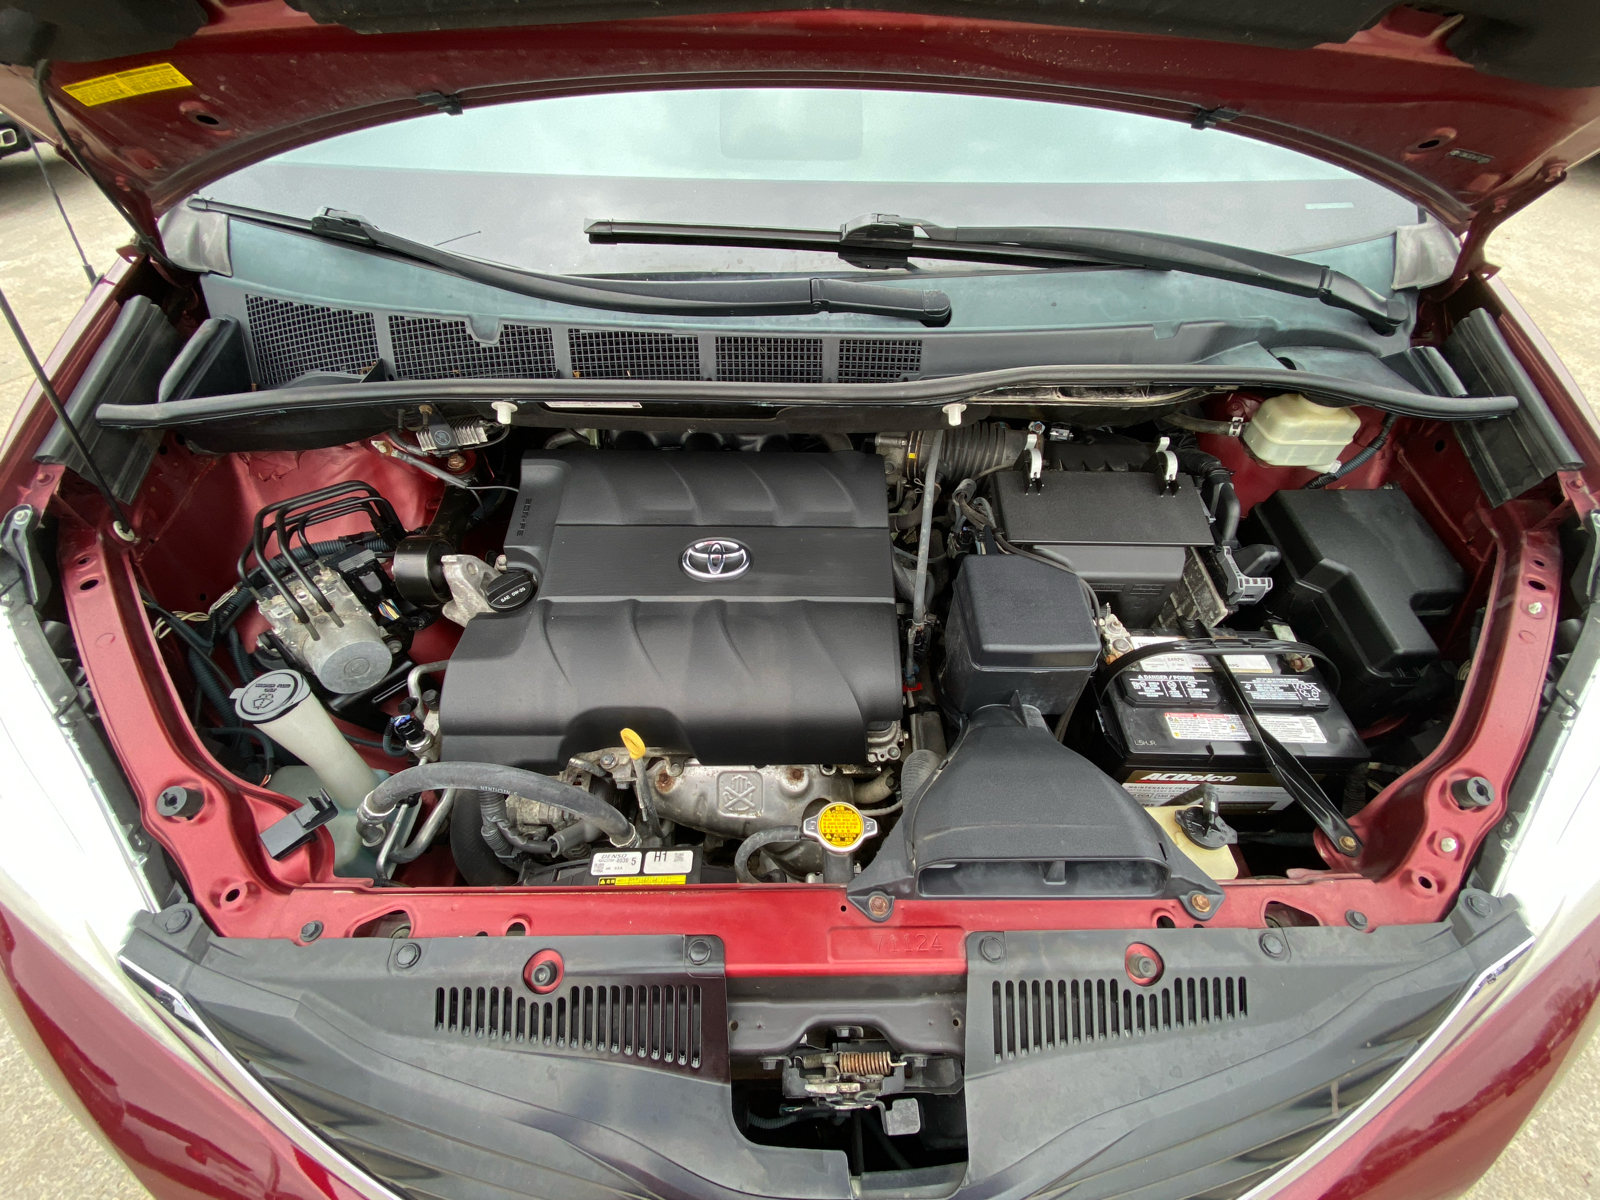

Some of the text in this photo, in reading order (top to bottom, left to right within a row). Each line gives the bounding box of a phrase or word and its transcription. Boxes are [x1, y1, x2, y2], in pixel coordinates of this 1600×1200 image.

[1139, 773, 1238, 782] ACDelco
[631, 857, 637, 866] 5
[653, 851, 668, 862] H1
[873, 932, 943, 952] 71124
